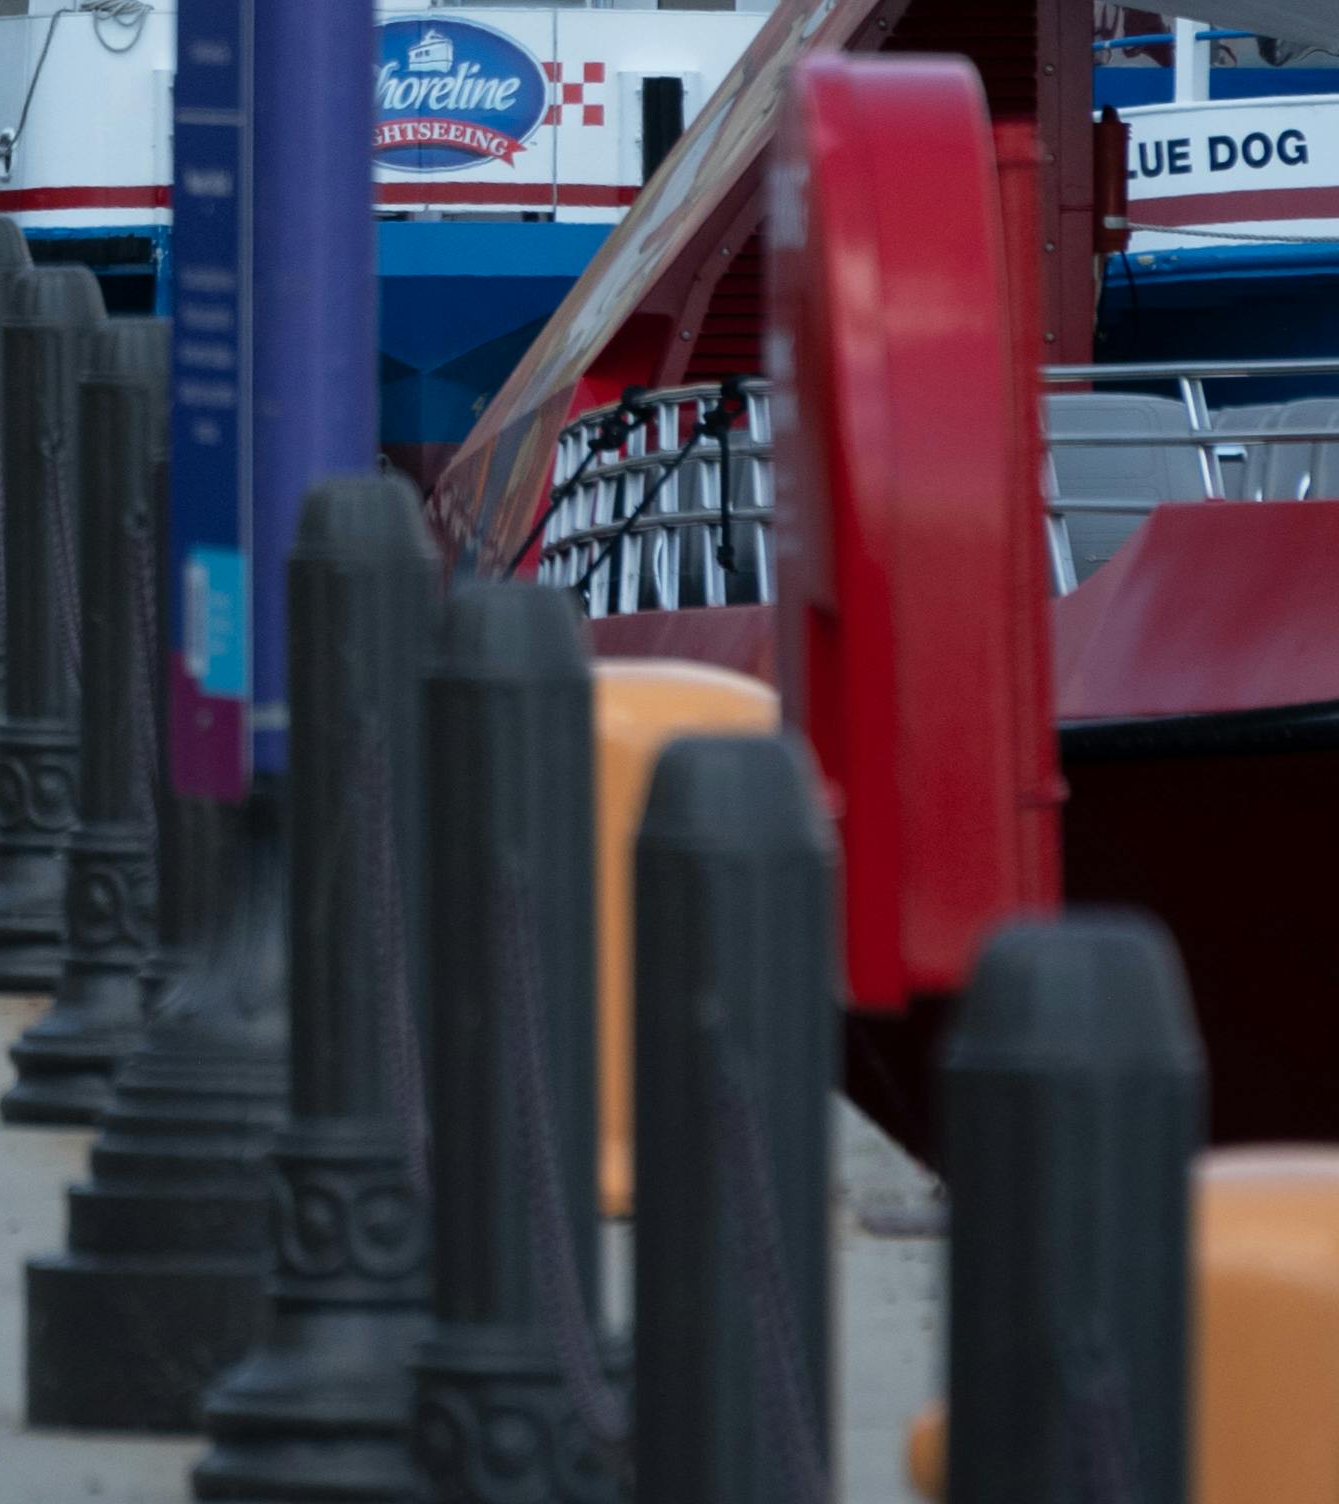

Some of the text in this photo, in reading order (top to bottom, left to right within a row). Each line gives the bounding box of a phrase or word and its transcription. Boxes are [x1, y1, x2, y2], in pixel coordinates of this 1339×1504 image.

[375, 61, 521, 111] horeline
[374, 121, 509, 156] GHTSEEING
[1208, 129, 1309, 173] DOG
